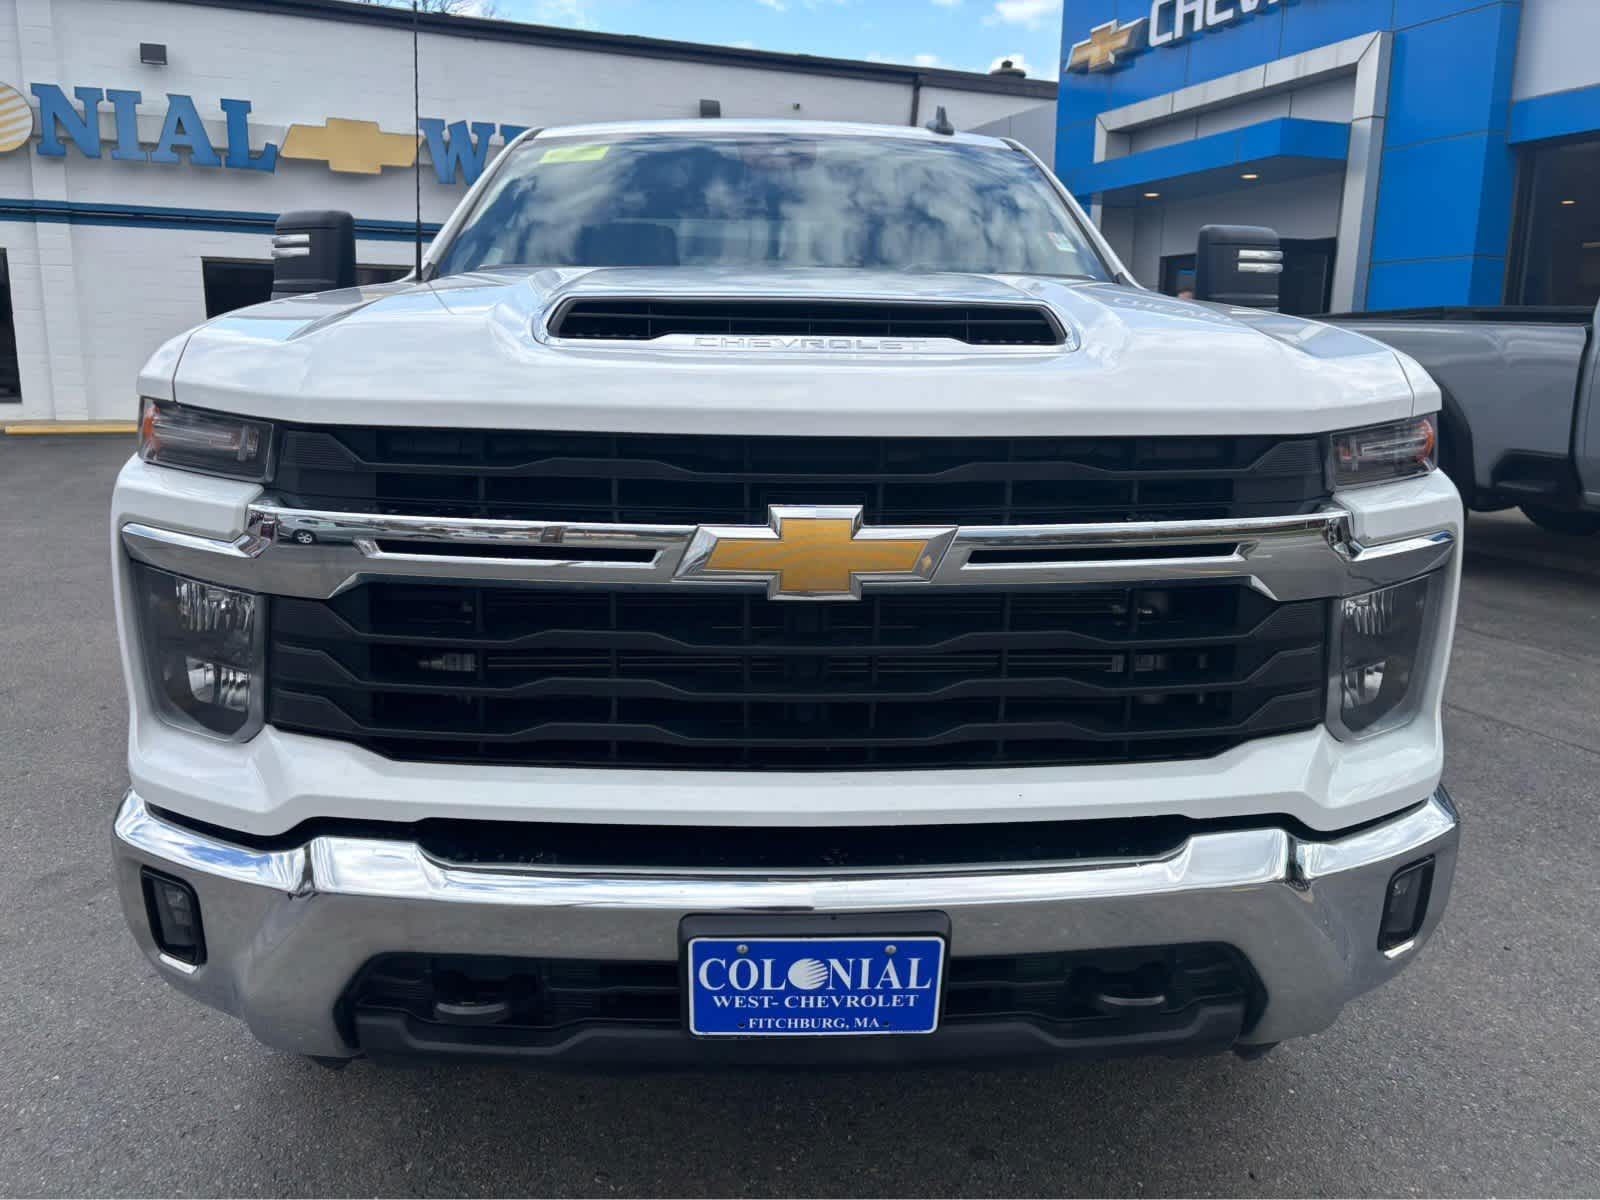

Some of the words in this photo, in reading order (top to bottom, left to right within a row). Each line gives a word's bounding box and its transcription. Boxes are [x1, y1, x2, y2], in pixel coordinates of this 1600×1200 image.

[694, 337, 927, 349] CHEVROLET
[699, 957, 932, 991] COLONIAL
[784, 995, 919, 1008] CHEVROLET
[854, 1016, 880, 1028] MA
